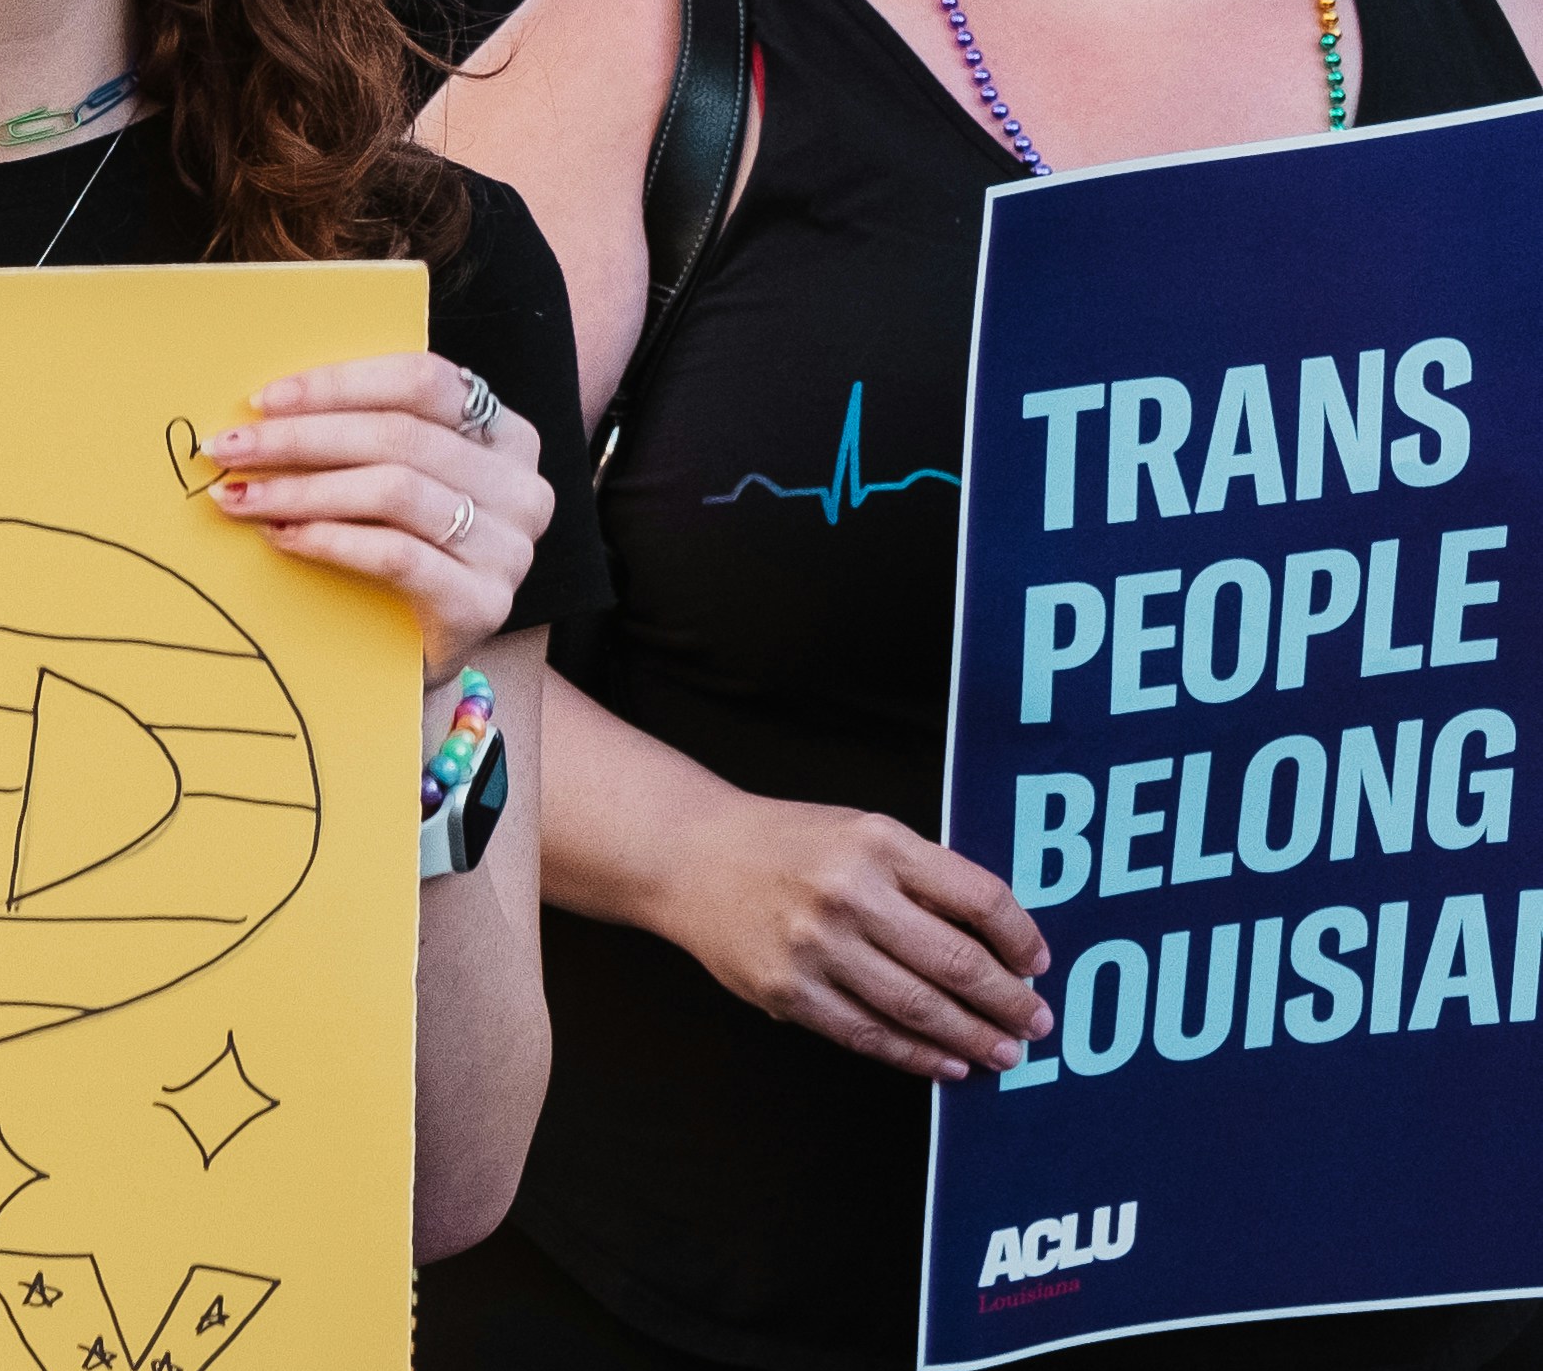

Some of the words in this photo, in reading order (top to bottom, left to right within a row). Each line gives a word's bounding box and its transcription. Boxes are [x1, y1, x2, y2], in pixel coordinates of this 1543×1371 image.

[1021, 336, 1474, 533] TRANS
[1018, 524, 1510, 726] PEOPLE
[1009, 708, 1518, 912] BELONG
[977, 1200, 1139, 1288] ACLU
[978, 1278, 1082, 1315] Louisiana
